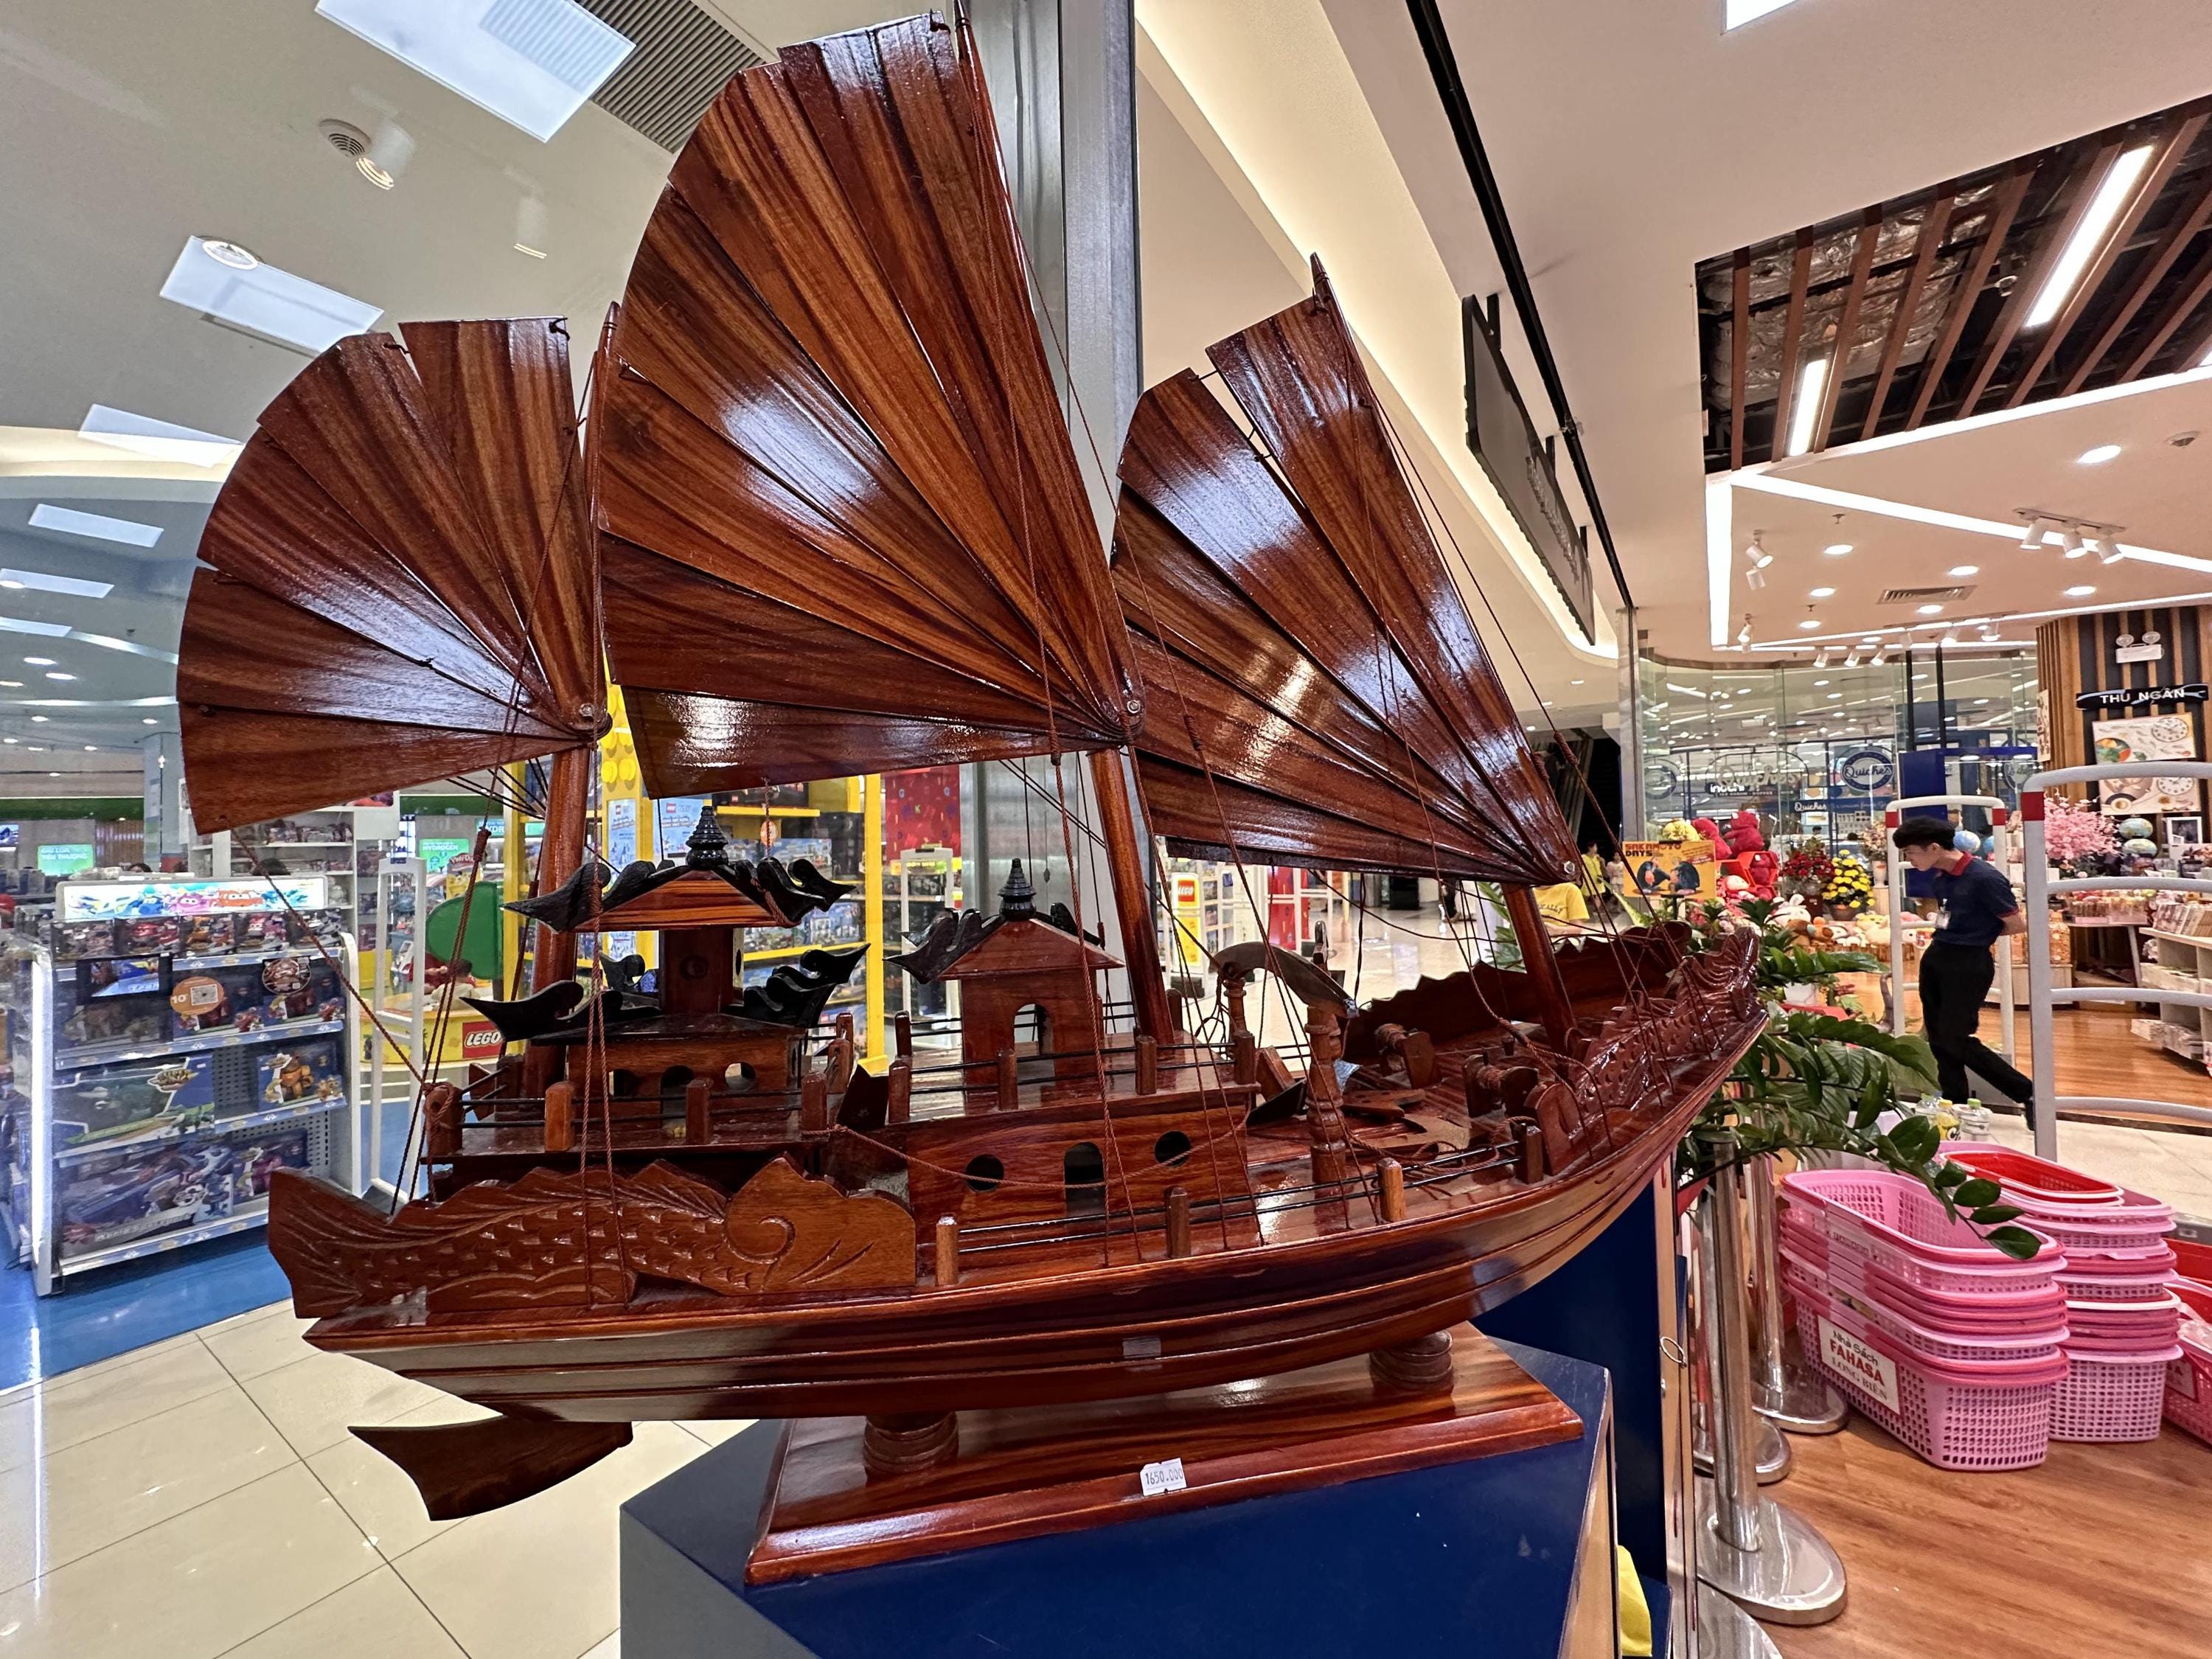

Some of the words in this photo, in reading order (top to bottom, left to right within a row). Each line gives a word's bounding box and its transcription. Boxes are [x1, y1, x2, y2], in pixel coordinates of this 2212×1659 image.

[2100, 694, 2130, 704] THU
[2138, 688, 2185, 701] NGÂN
[1717, 765, 1798, 787] Quiches
[1844, 765, 1892, 779] Quiches
[1795, 801, 1827, 812] Quiches
[1179, 886, 1194, 896] LEGO
[466, 1031, 501, 1046] LEGO
[1833, 1330, 1852, 1349] Nhà
[1854, 1343, 1879, 1366] Sách
[1830, 1338, 1885, 1386] FAHASA
[1832, 1357, 1860, 1382] LONG
[1145, 1468, 1183, 1485] 1650.000
